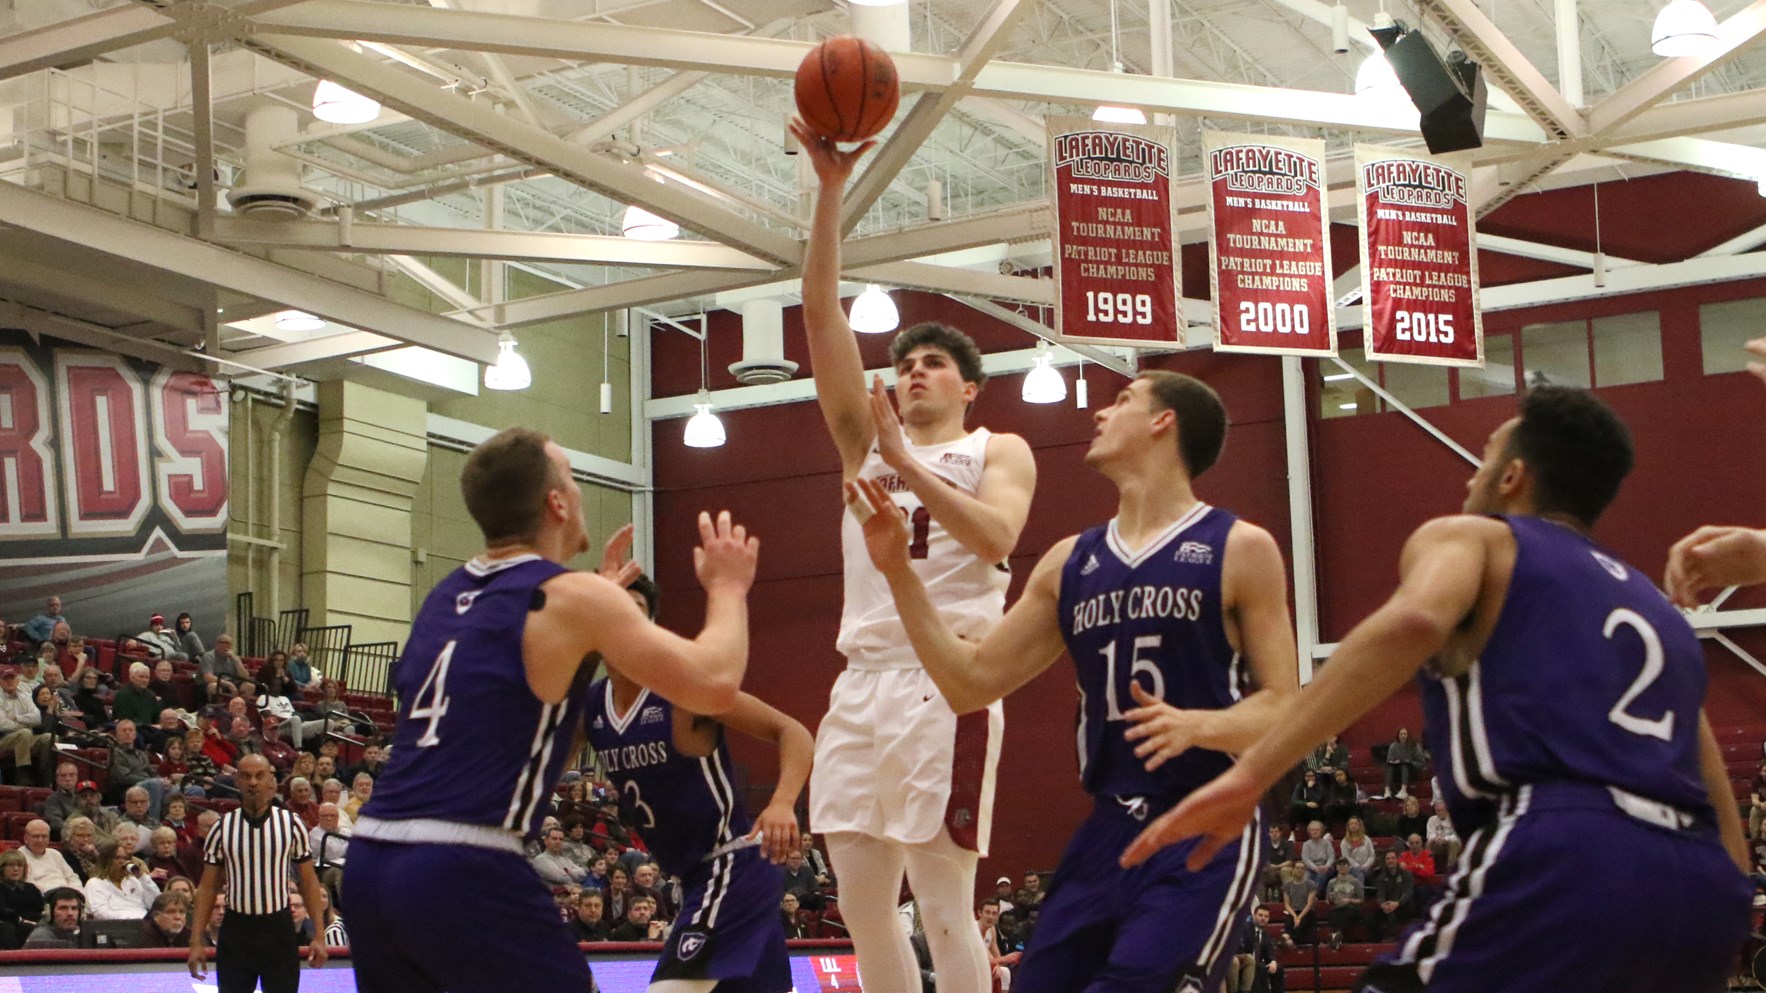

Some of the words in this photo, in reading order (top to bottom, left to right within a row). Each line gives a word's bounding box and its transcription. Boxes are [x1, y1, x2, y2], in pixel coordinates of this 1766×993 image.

[1055, 133, 1169, 173] LAFAYETTE
[1074, 160, 1153, 179] LEOPARDS
[1212, 147, 1319, 185] LAFAYETTE
[1229, 173, 1305, 193] LEOPARDS
[1364, 161, 1465, 199] LAFAYETTE
[1070, 183, 1099, 196] MEN'S
[1101, 186, 1158, 200] BASKETBALL
[1381, 186, 1452, 206] LEOPARDS
[1225, 196, 1252, 209] MEN'S
[1254, 198, 1310, 212] BASKETBALL
[1098, 207, 1132, 222] NCAA
[1376, 208, 1402, 220] MEN'S
[1405, 211, 1457, 226] BASKETBALL
[1071, 222, 1161, 241] TOURNAMENT
[1252, 219, 1286, 235] NCAA
[1226, 234, 1313, 253] TOURNAMENT
[1402, 231, 1435, 246] NCAA
[1065, 244, 1117, 262] PATRIOT
[1122, 248, 1170, 265] LEAGUE
[1378, 246, 1459, 265] TOURNAMENT
[1080, 264, 1155, 281] CHAMPIONS
[1221, 256, 1272, 273] PATRIOT
[1276, 260, 1323, 276] LEAGUE
[1237, 275, 1309, 292] CHAMPIONS
[1373, 267, 1421, 284] PATRIOT
[1425, 272, 1468, 288] LEAGUE
[1389, 285, 1456, 303] CHAMPIONS
[1086, 291, 1152, 325] 1999
[1240, 301, 1309, 335] 2000
[1395, 310, 1454, 344] 2015
[1073, 590, 1125, 635] HOLY
[1127, 585, 1203, 621] CROSS
[1098, 634, 1166, 721] 15
[1602, 607, 1675, 742] 2
[409, 640, 457, 748] 4
[622, 741, 667, 769] CROSS
[624, 779, 656, 828] 3
